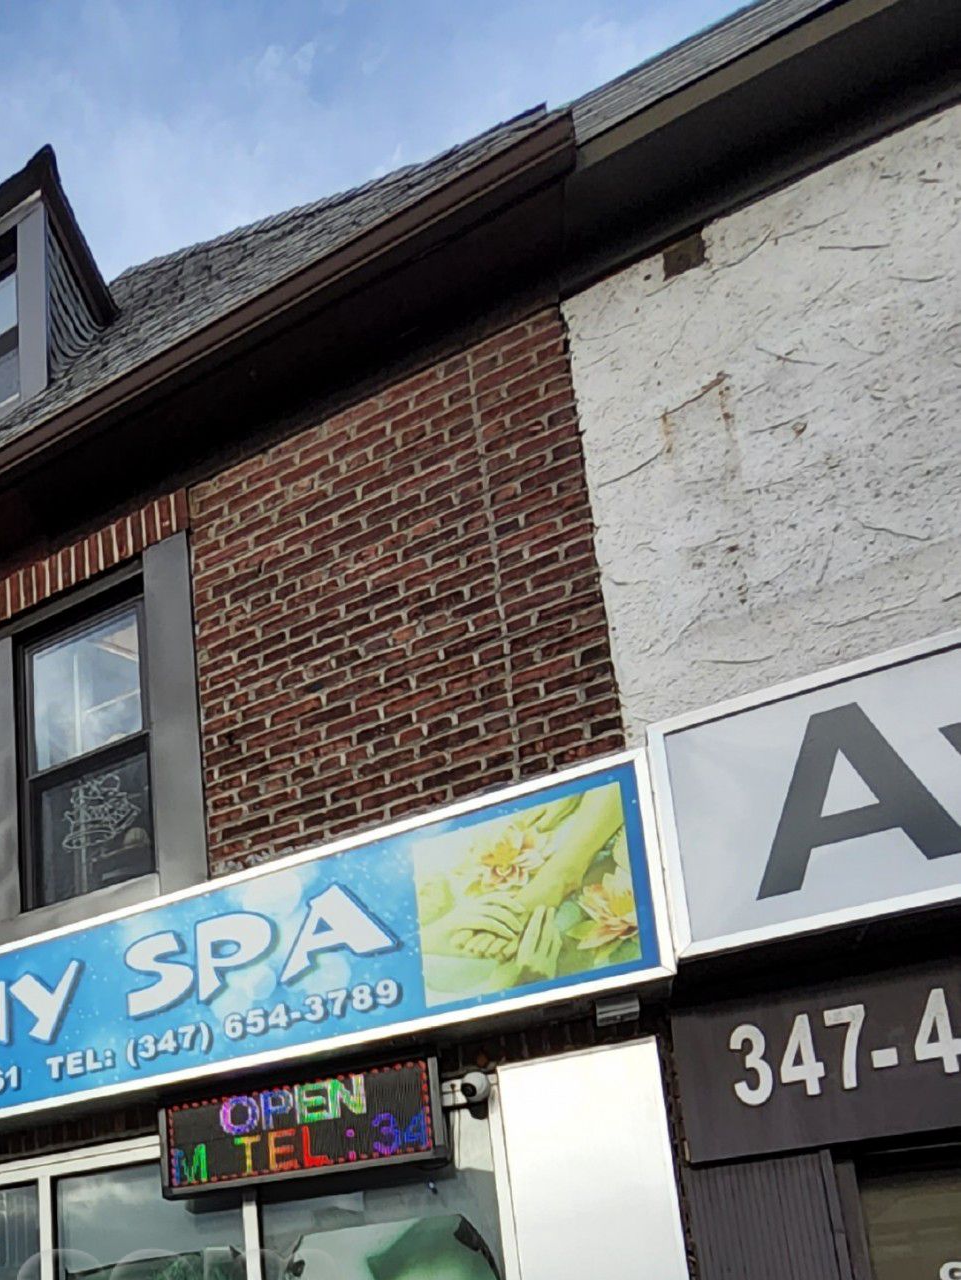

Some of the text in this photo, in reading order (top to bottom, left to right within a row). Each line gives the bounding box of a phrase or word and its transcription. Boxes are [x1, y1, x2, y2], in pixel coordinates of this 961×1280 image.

[757, 702, 961, 901] A
[123, 883, 400, 1018] SPA
[46, 1047, 116, 1081] TEL:
[125, 1020, 213, 1068] (347)
[223, 979, 401, 1040] 654-3789
[219, 1073, 367, 1135] OPEN
